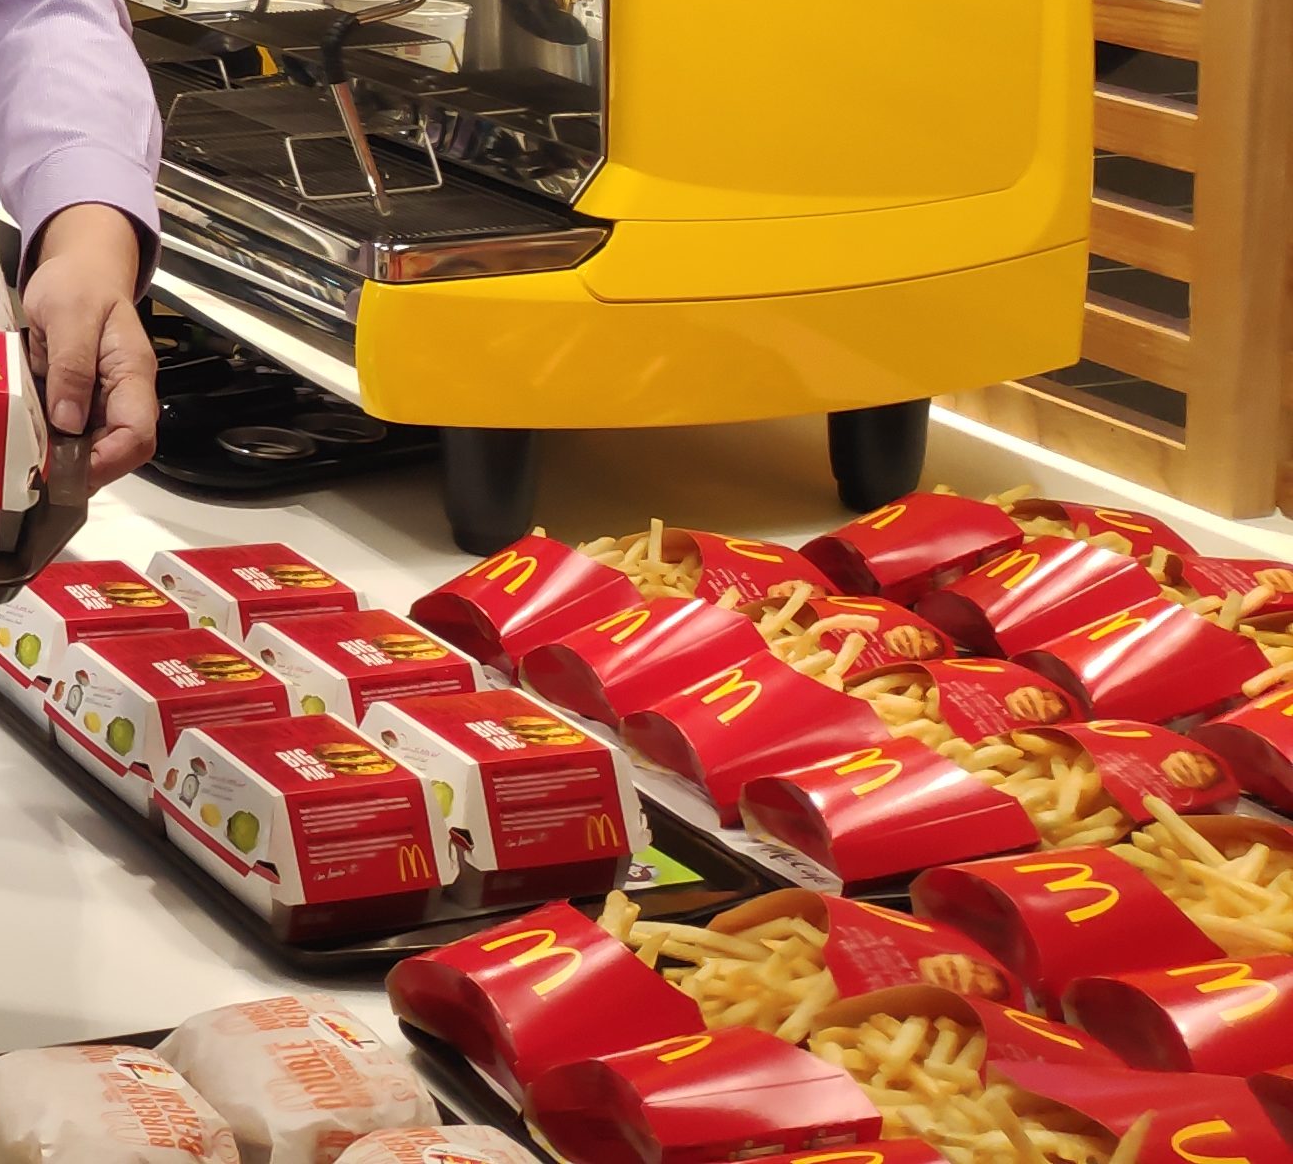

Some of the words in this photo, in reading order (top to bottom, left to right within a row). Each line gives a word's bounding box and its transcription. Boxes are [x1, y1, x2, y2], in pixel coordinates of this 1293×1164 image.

[232, 567, 270, 581] BIG
[64, 584, 101, 598] BIG
[248, 579, 282, 591] MAC
[78, 597, 112, 610] MAC
[337, 638, 378, 654] BIG
[356, 651, 393, 667] MAC
[152, 658, 193, 677] BIG
[169, 674, 205, 688] MAC
[465, 720, 511, 738] BIG
[486, 735, 527, 751] MAC
[275, 748, 318, 768] BIG
[294, 764, 335, 781] MAC
[277, 1039, 351, 1110] DOUBLE
